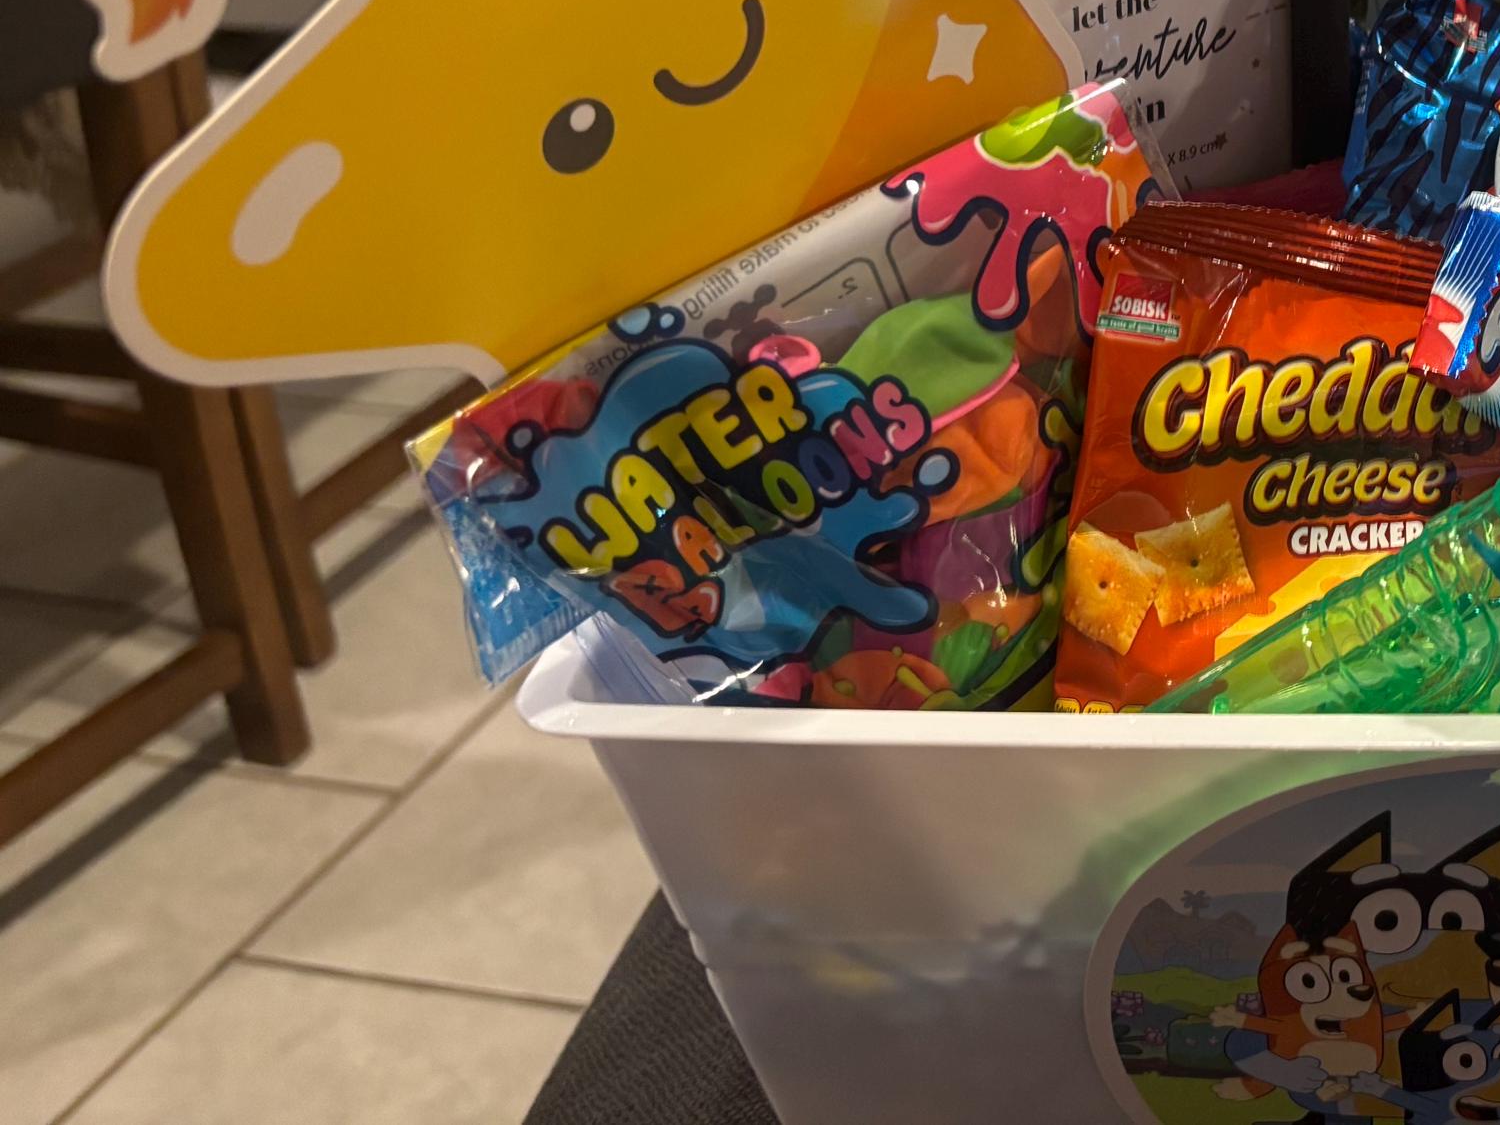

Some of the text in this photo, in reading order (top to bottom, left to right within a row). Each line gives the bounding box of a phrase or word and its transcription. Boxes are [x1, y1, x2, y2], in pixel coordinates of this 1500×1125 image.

[1072, 4, 1107, 33] let
[1112, 295, 1168, 320] SOBISK
[546, 365, 808, 577] WATER
[609, 381, 925, 633] BALOONS
[1290, 520, 1425, 556] CRACKER
